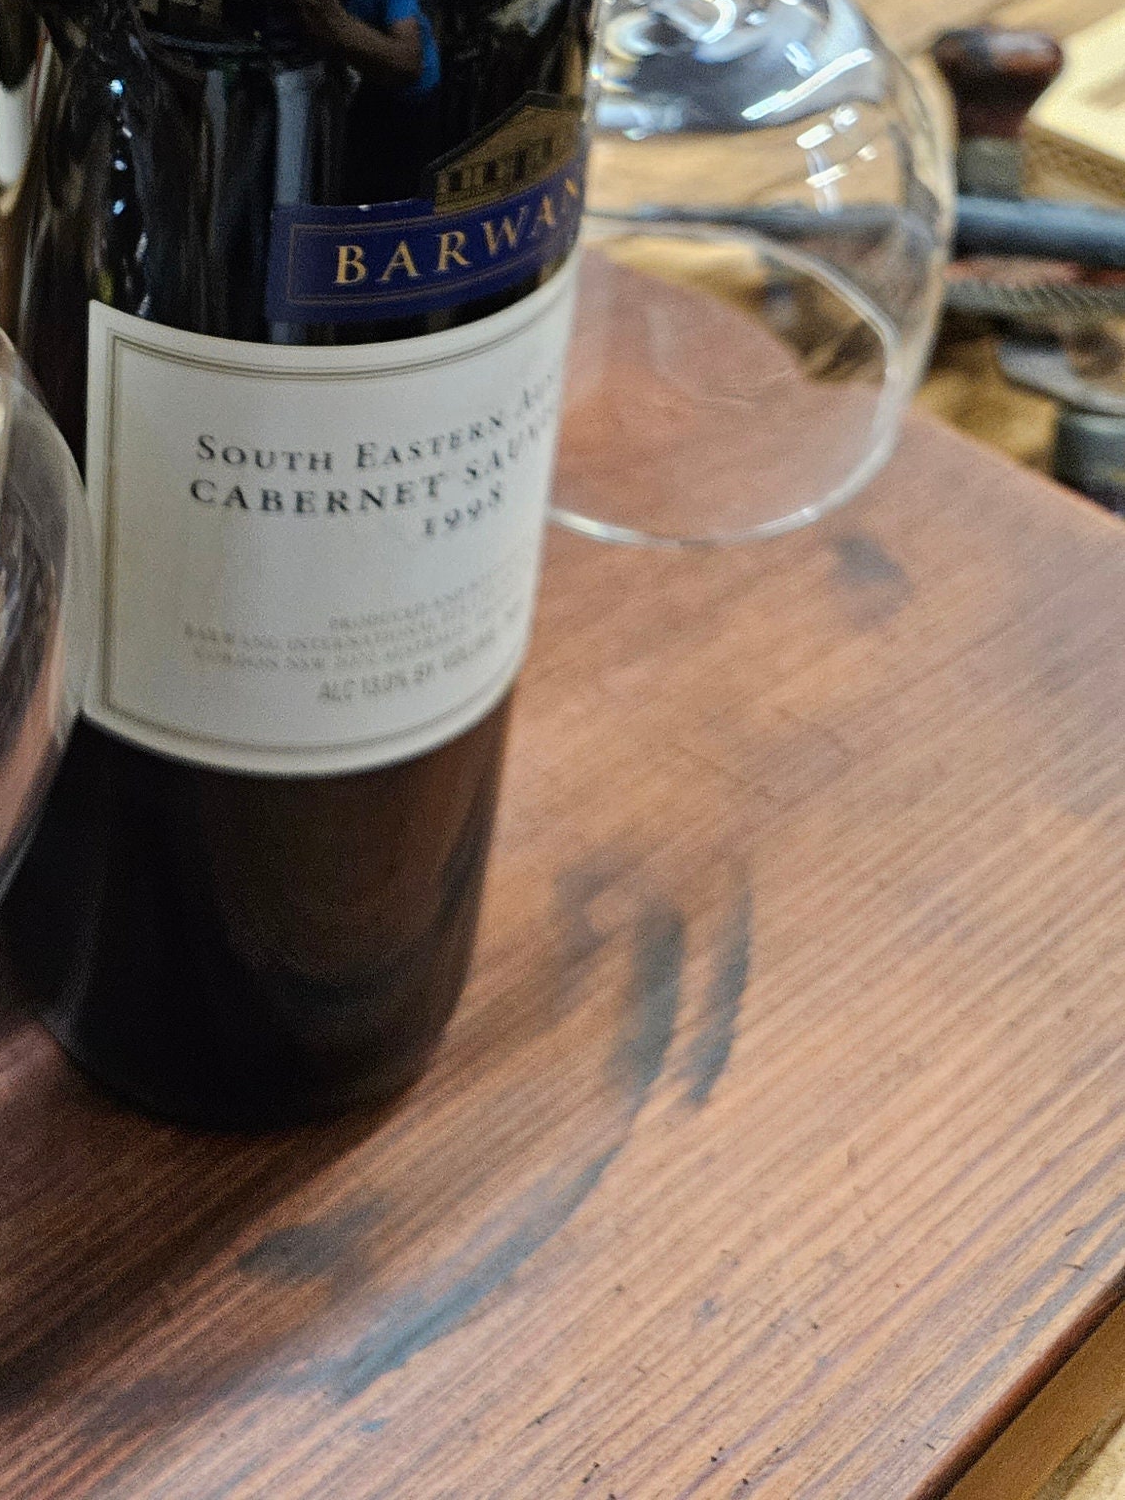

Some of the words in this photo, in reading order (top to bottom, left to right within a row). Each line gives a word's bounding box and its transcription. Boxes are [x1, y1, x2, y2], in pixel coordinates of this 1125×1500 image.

[197, 433, 332, 472] SOUTH
[356, 409, 504, 468] EASTERN
[190, 471, 448, 514] CABERNET
